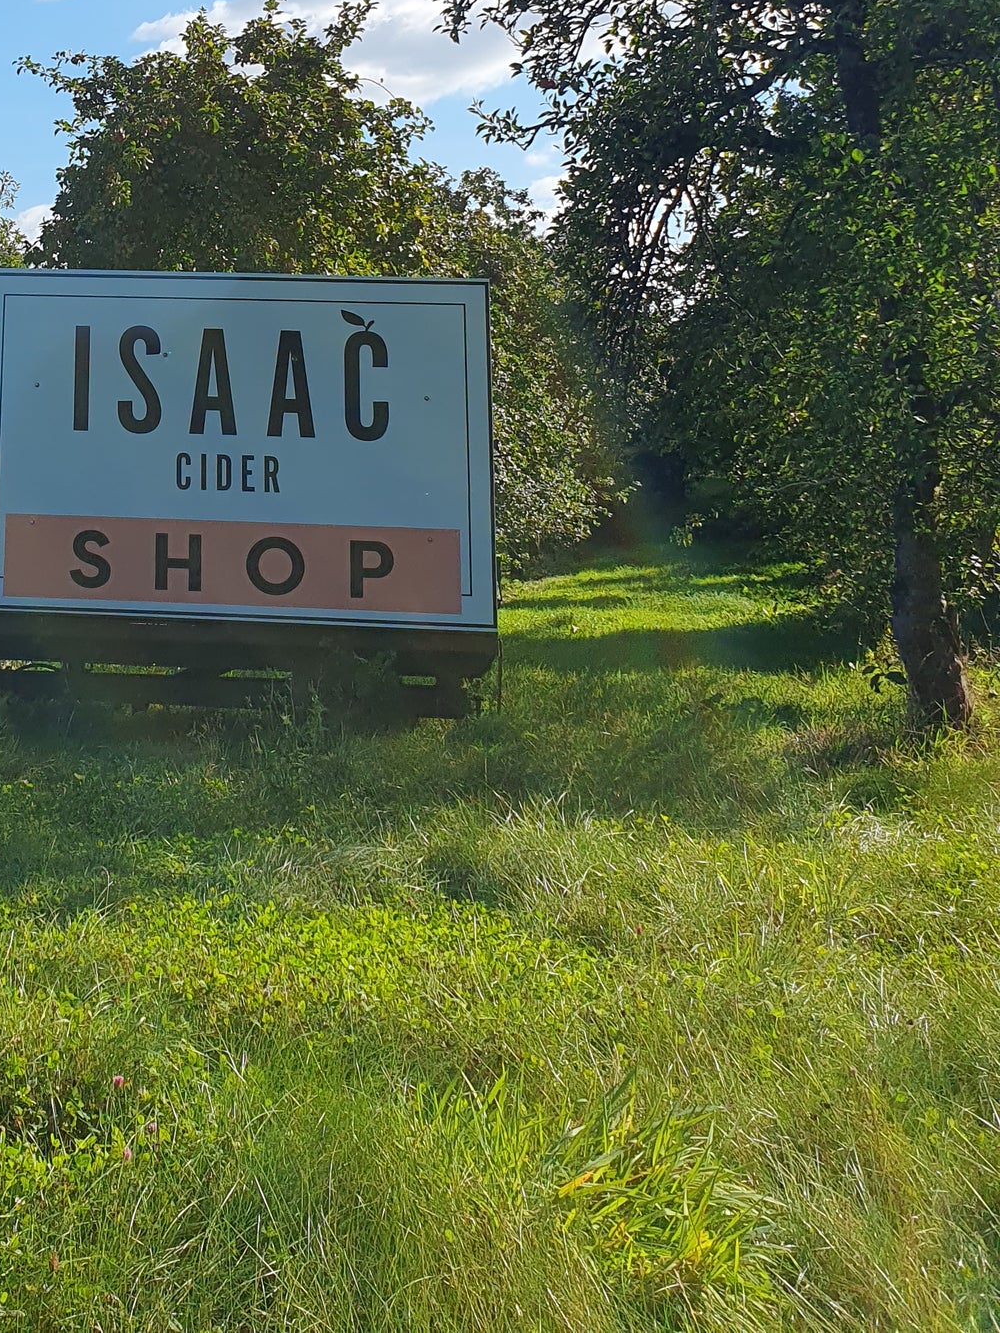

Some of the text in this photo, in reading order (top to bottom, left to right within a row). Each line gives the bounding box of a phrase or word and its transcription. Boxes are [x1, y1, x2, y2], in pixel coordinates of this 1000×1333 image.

[73, 325, 390, 442] ISAAC
[175, 452, 281, 494] CIDER
[69, 529, 395, 599] SHOP
